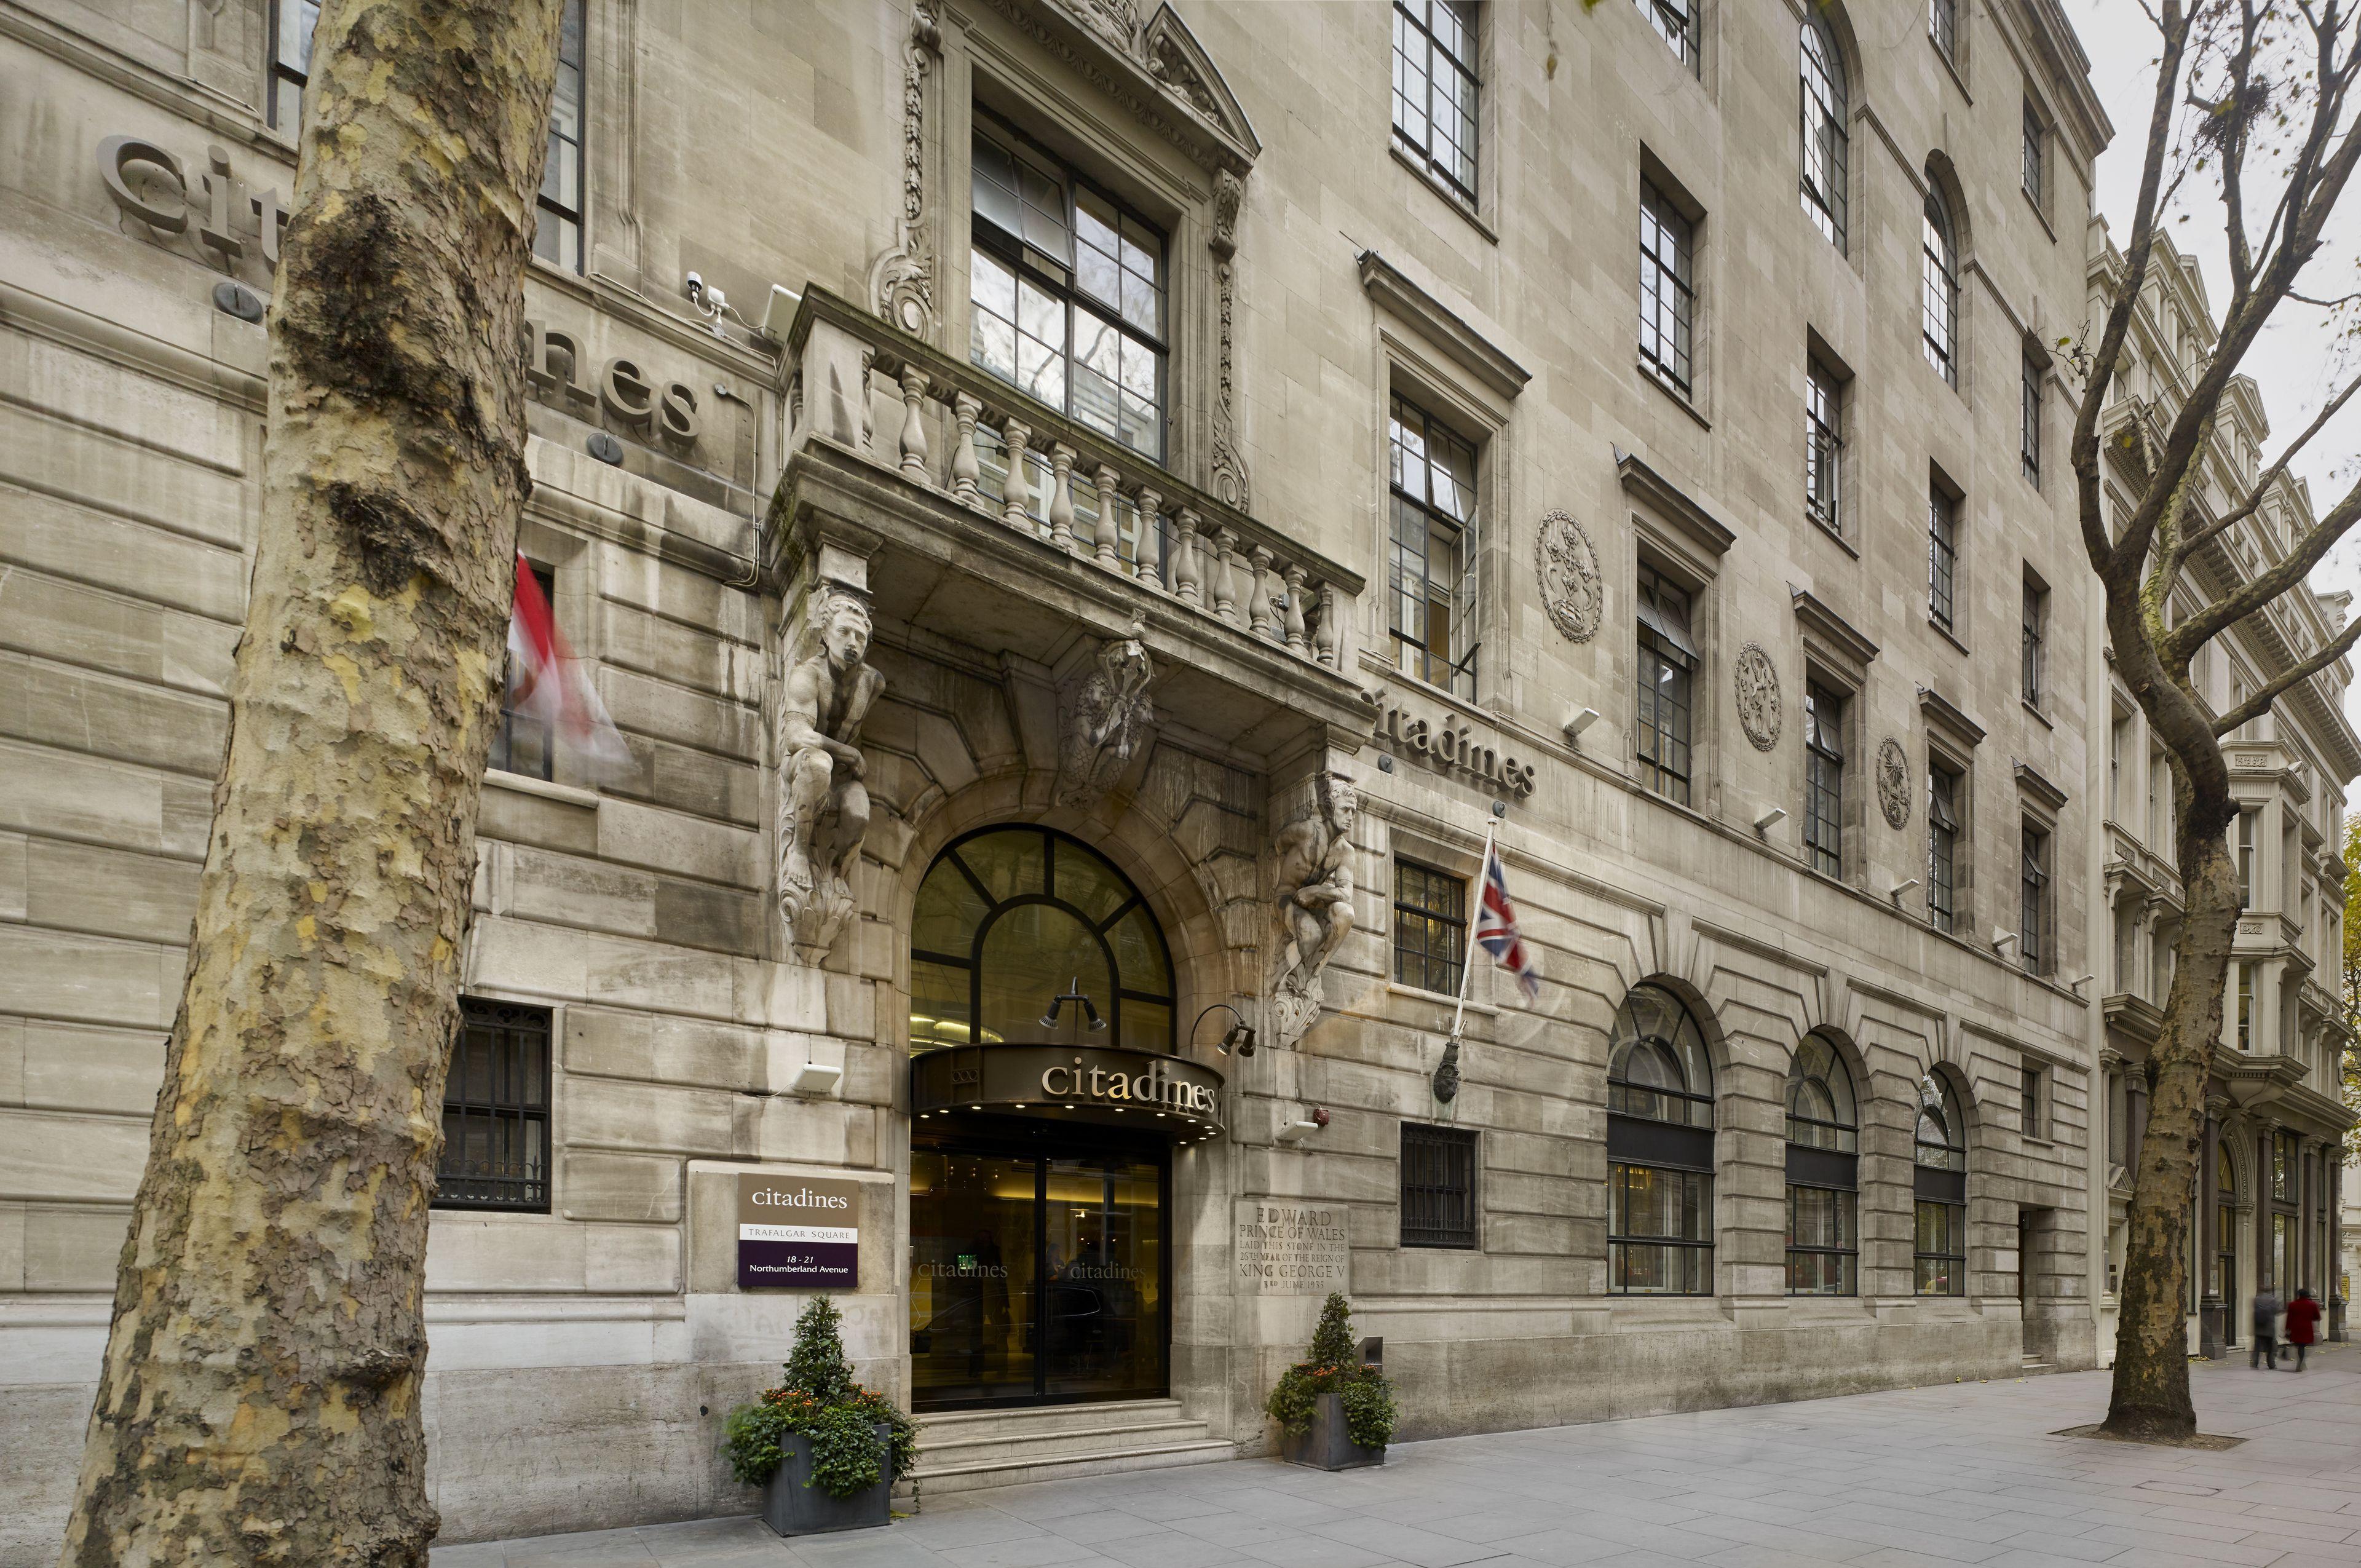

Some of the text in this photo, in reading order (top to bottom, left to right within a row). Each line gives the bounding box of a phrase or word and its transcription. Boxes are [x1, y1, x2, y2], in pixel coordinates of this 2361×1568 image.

[1042, 1056, 1215, 1114] citadines
[752, 1187, 847, 1209] citadines
[1256, 1207, 1332, 1226] EDWARD
[748, 1229, 850, 1240] TRAFALGAR SQUARE
[1240, 1224, 1345, 1241] PRINCE OF WALES
[1240, 1240, 1345, 1252] LAID THIS STONE IN THE
[1260, 1253, 1280, 1261] YEAR
[1282, 1253, 1292, 1262] OF
[1294, 1254, 1309, 1262] THE
[1311, 1254, 1333, 1263] REIGN
[1335, 1254, 1344, 1263] OF
[749, 1264, 817, 1273] Northumberland
[1070, 1261, 1147, 1280] citadines
[1240, 1264, 1345, 1278] KING GEORGE V
[1280, 1281, 1304, 1289] JUNE
[1307, 1281, 1324, 1289] 1935
